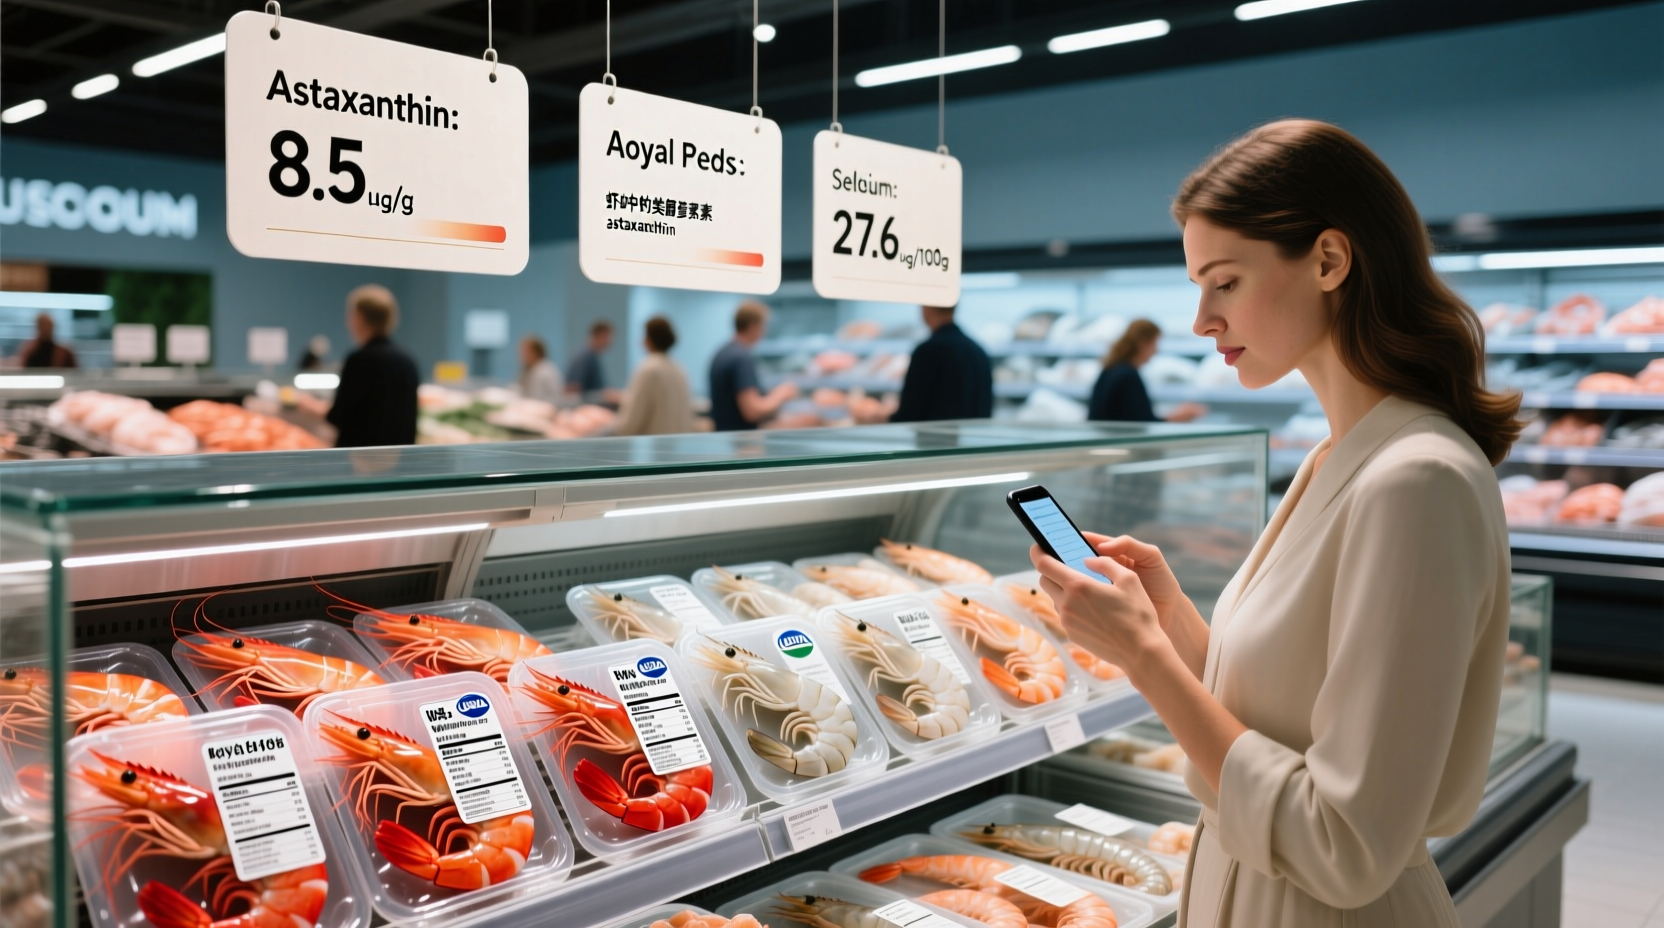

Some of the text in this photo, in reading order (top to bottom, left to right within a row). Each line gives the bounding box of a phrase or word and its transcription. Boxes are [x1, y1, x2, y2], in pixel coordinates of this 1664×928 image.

[266, 69, 459, 130] Astaxanthin:
[606, 130, 745, 176] Aoyal Peds:
